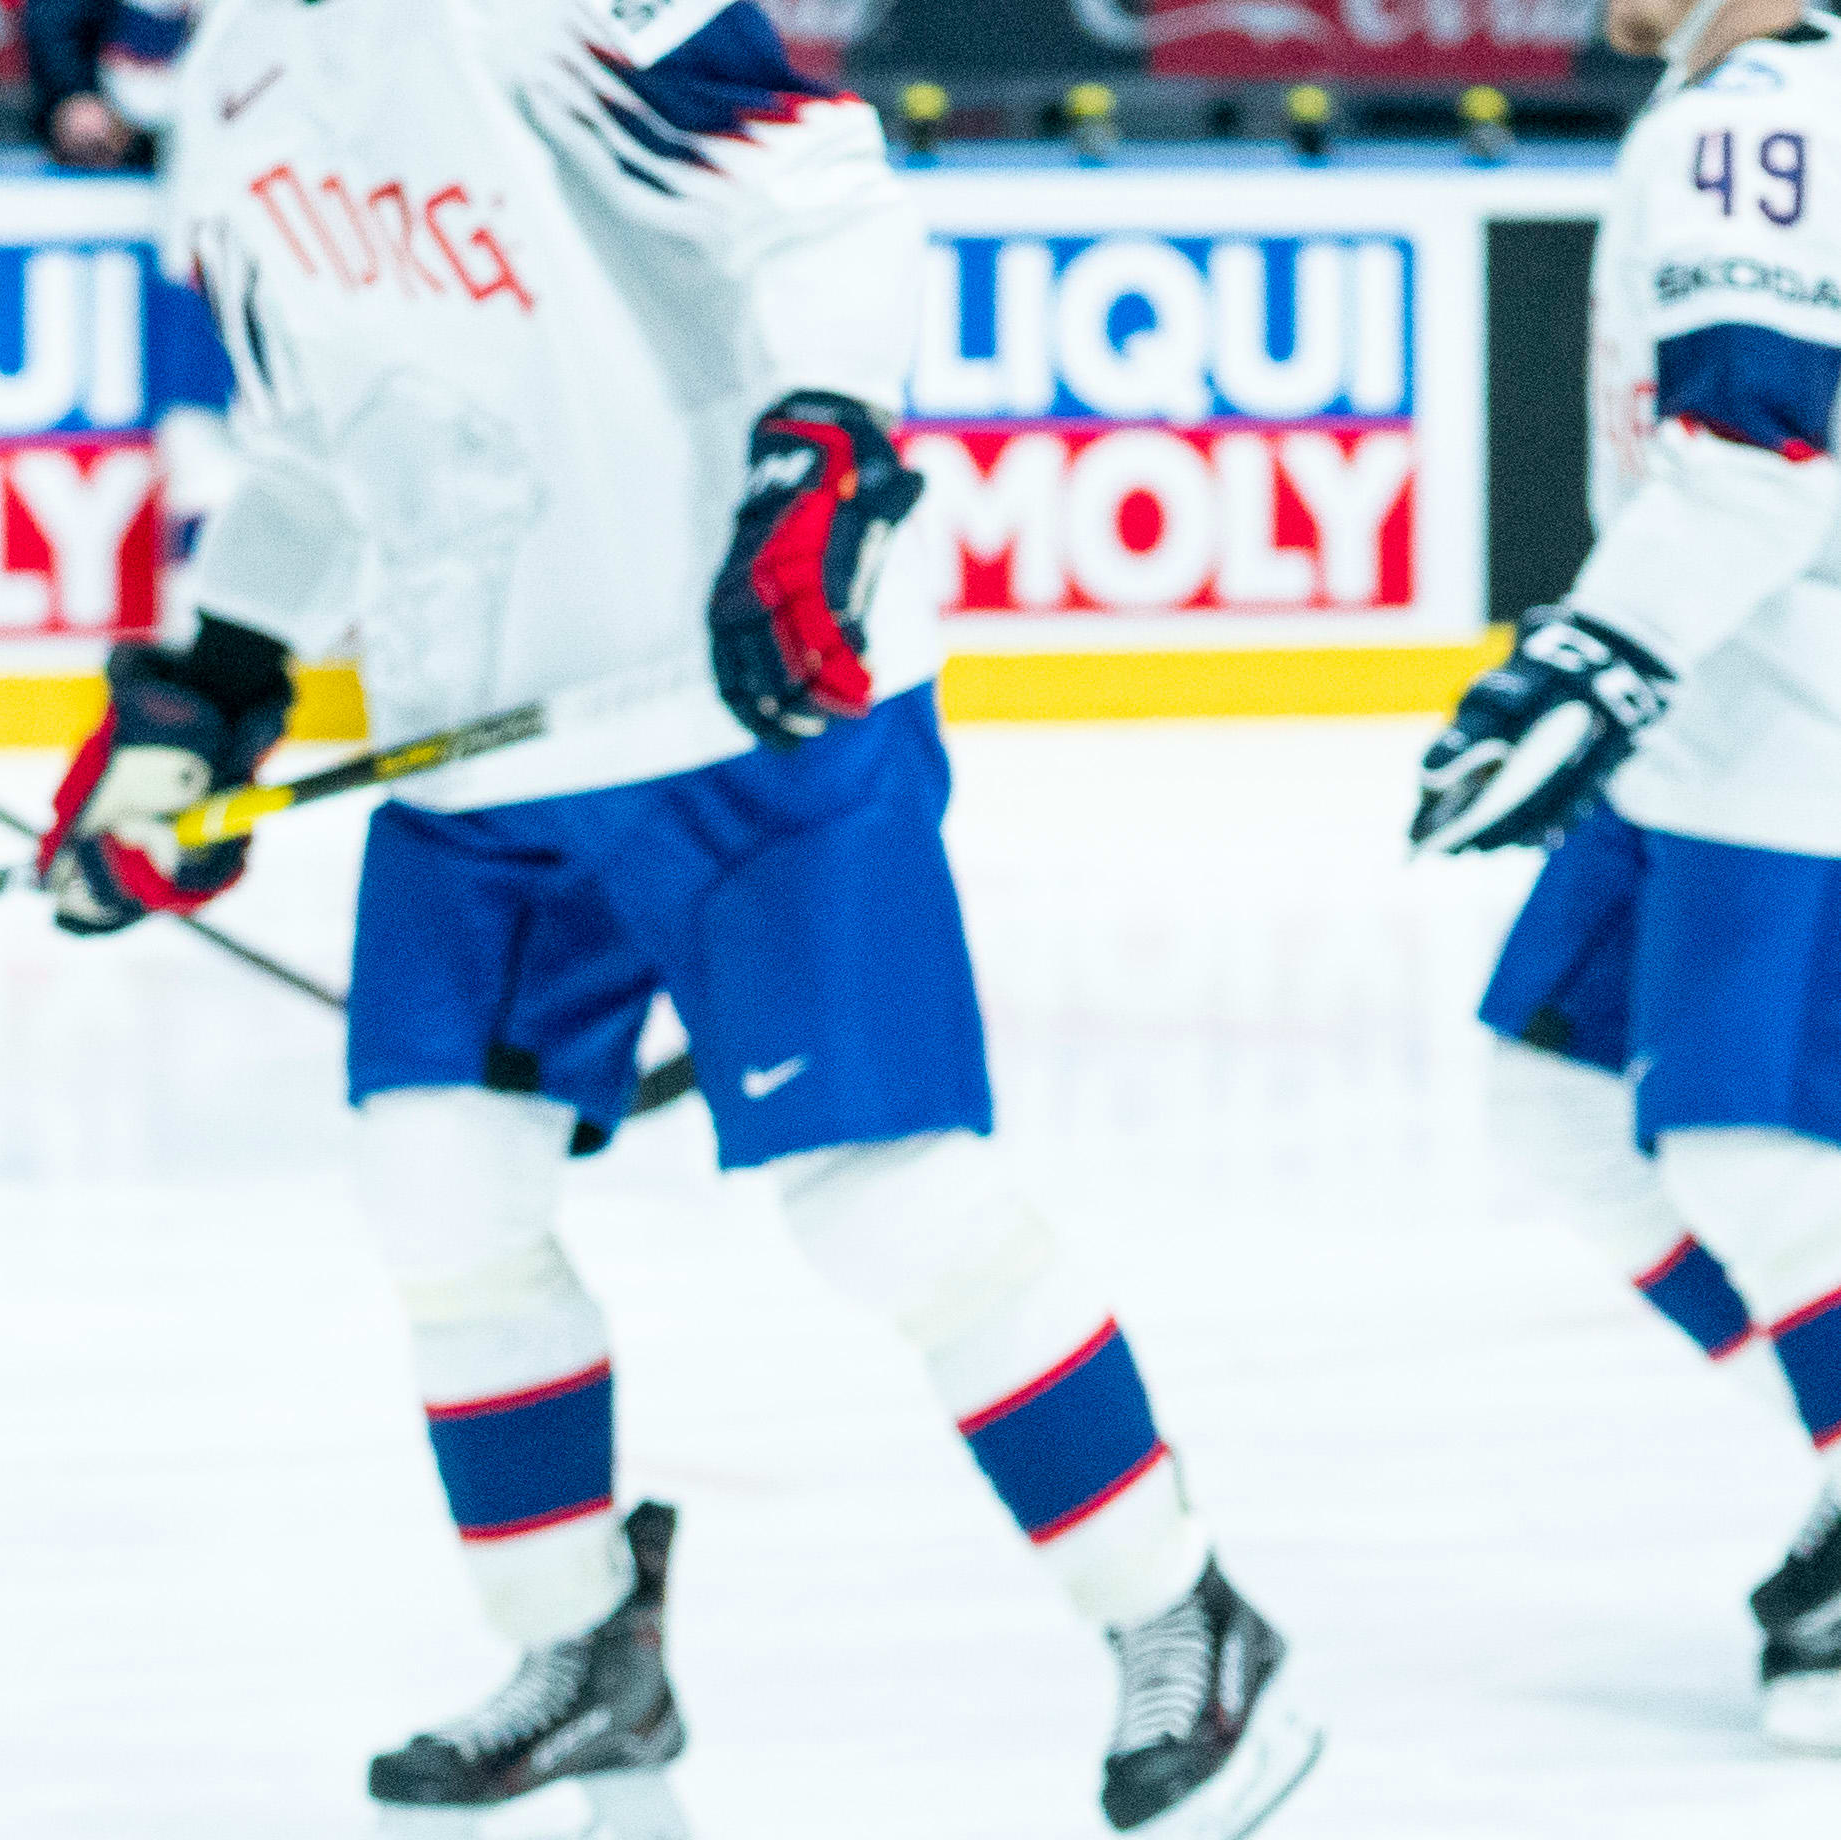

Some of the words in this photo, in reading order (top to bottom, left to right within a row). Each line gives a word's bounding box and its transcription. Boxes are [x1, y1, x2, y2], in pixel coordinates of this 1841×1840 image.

[1692, 128, 1806, 227] 49
[921, 238, 1403, 426] LIQUI
[919, 428, 1413, 608] MOLY
